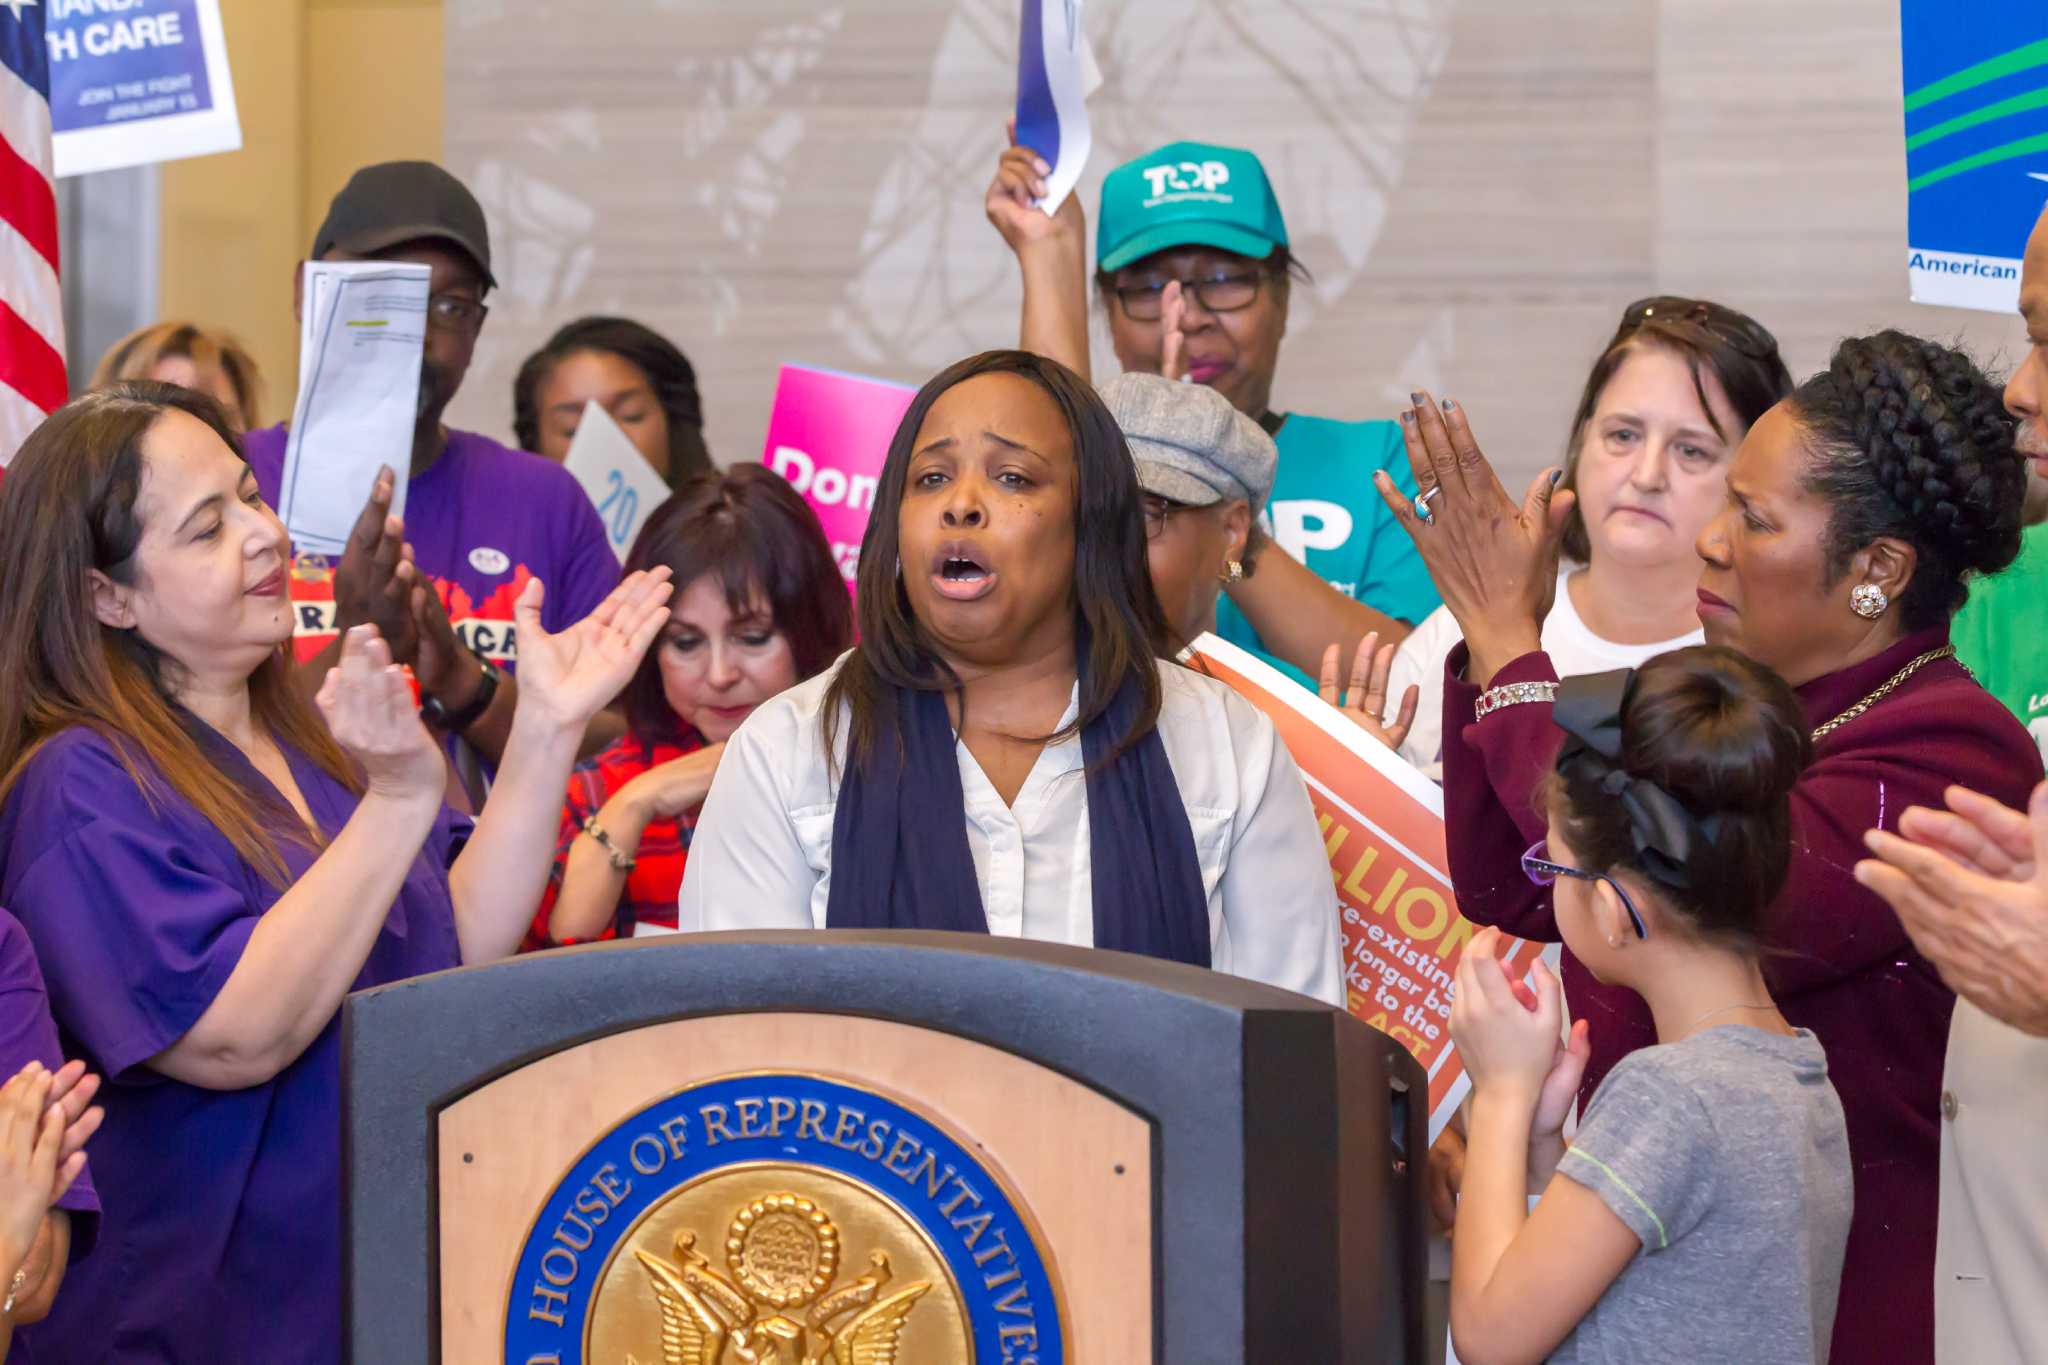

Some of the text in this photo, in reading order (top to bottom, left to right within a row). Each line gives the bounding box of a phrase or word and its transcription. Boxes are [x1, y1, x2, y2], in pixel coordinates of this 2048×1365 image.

[45, 11, 184, 62] H CARE
[1142, 161, 1230, 197] TOP
[1909, 253, 2018, 281] American
[1258, 499, 1353, 565] P
[1341, 901, 1456, 1003] e-existing
[1353, 938, 1423, 995] longer
[1424, 988, 1451, 1019] be
[1345, 960, 1440, 1040] ks to the
[529, 1161, 634, 1328] HOUSE
[629, 1114, 689, 1176] OF
